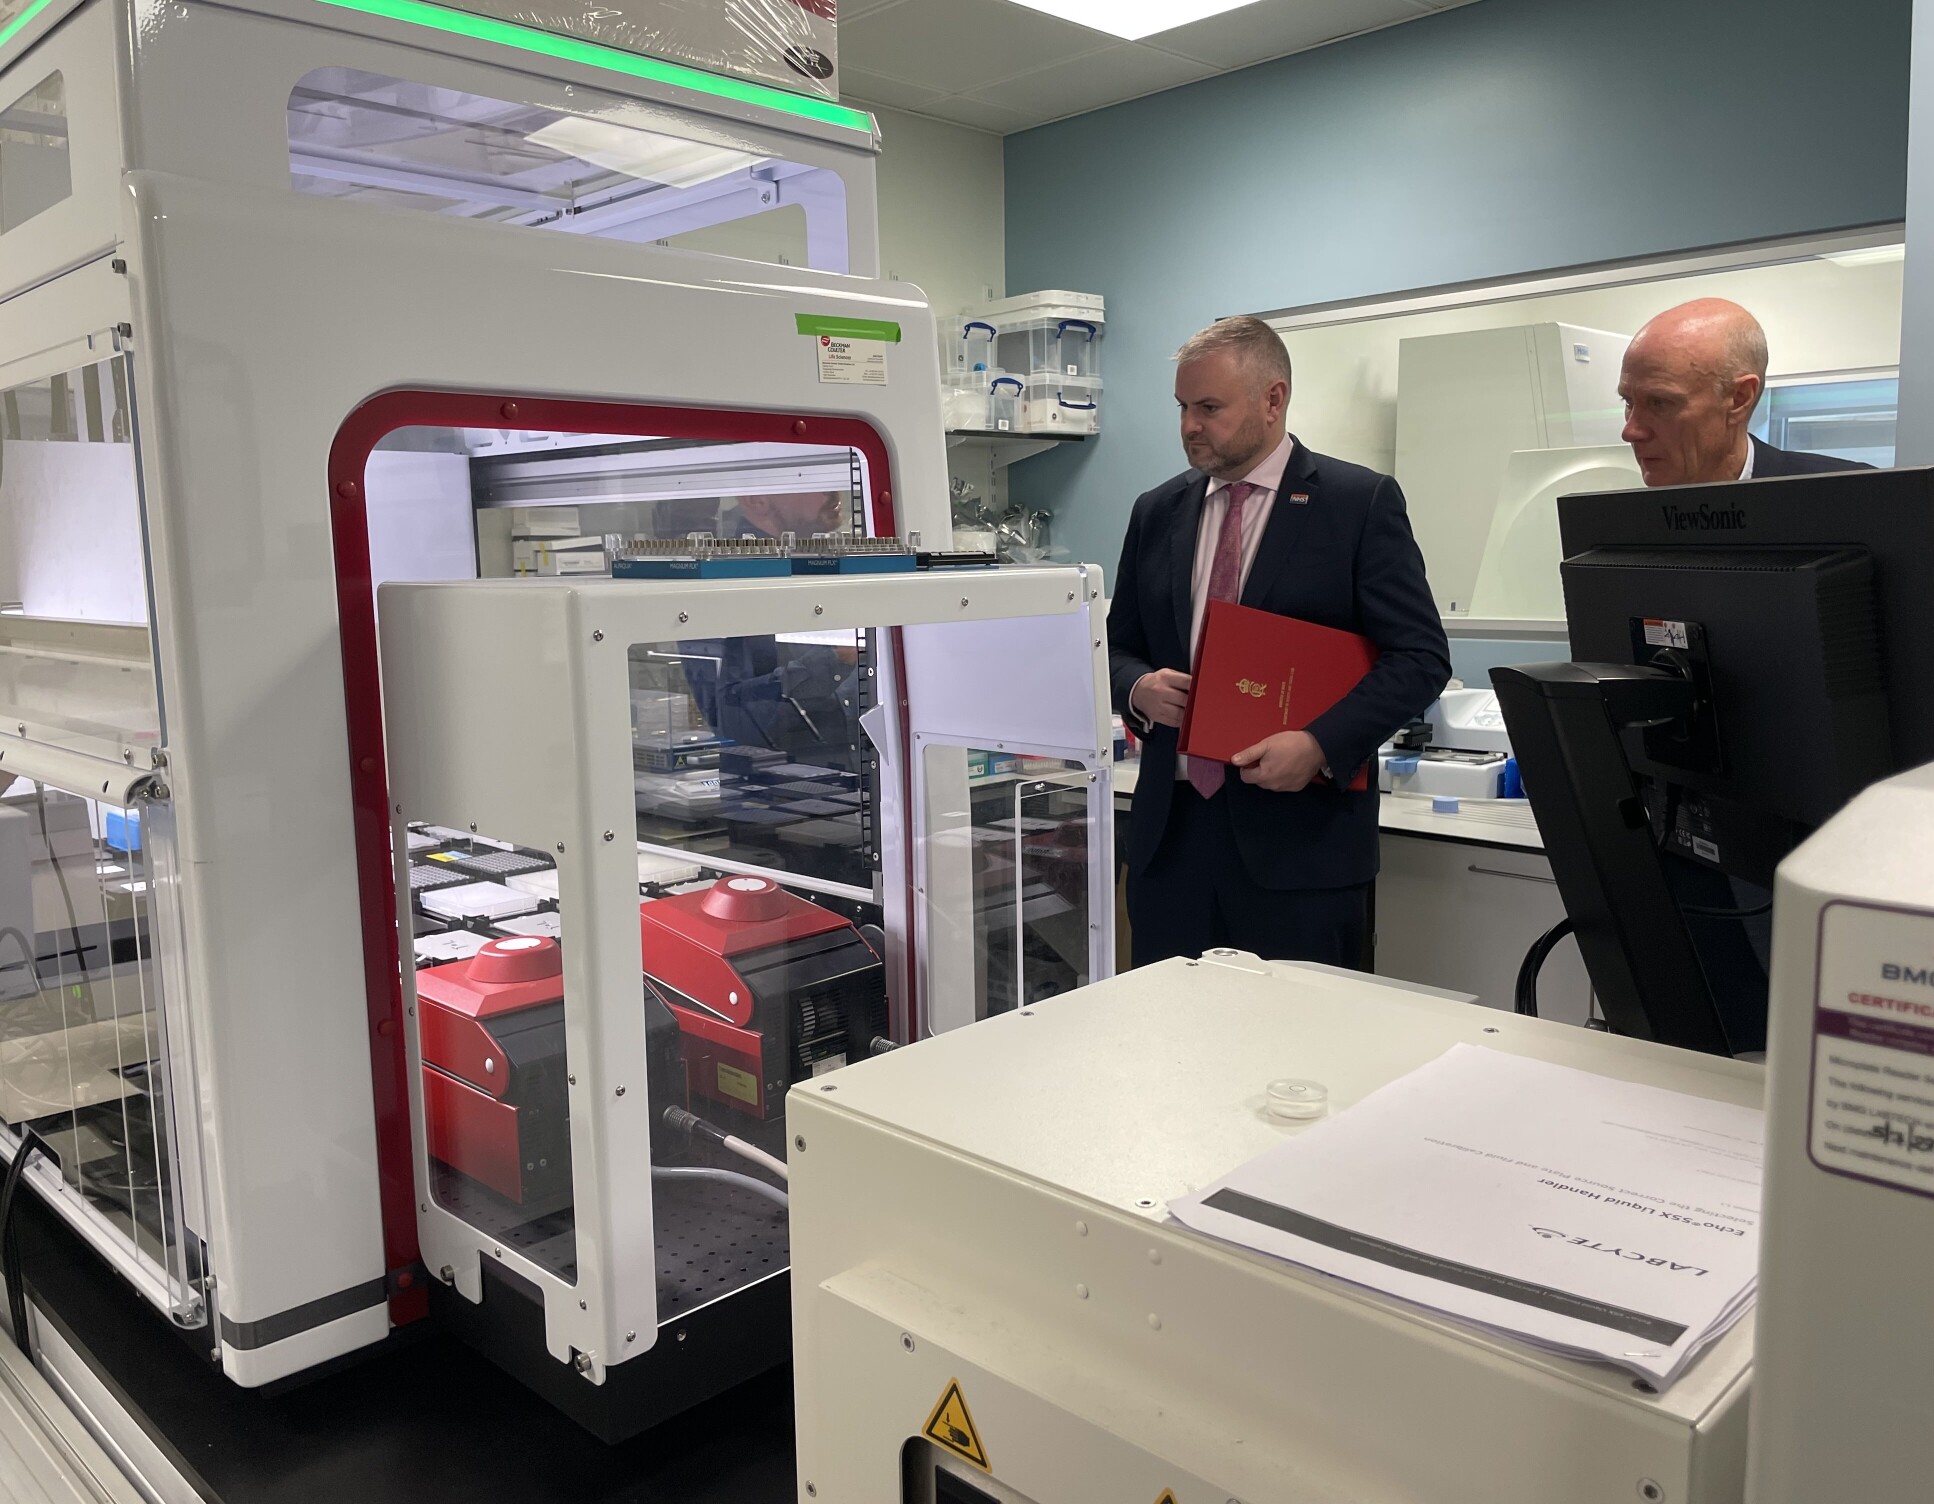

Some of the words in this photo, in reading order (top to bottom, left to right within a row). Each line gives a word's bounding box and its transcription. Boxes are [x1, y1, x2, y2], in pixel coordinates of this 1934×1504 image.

[1662, 502, 1746, 531] ViewSonic
[1848, 992, 1934, 1018] CERTIFIC
[1424, 1136, 1483, 1155] Calibration
[1484, 1152, 1513, 1163] Fluid
[1514, 1160, 1539, 1170] and
[1541, 1167, 1572, 1179] Plate
[1537, 1178, 1601, 1200] Handler
[1574, 1177, 1616, 1191] Source
[1618, 1188, 1665, 1204] Correct
[1603, 1197, 1656, 1215] Liquid
[1669, 1201, 1690, 1211] the
[1694, 1207, 1755, 1226] Selecting
[1566, 1236, 1709, 1277] LABCYTE
